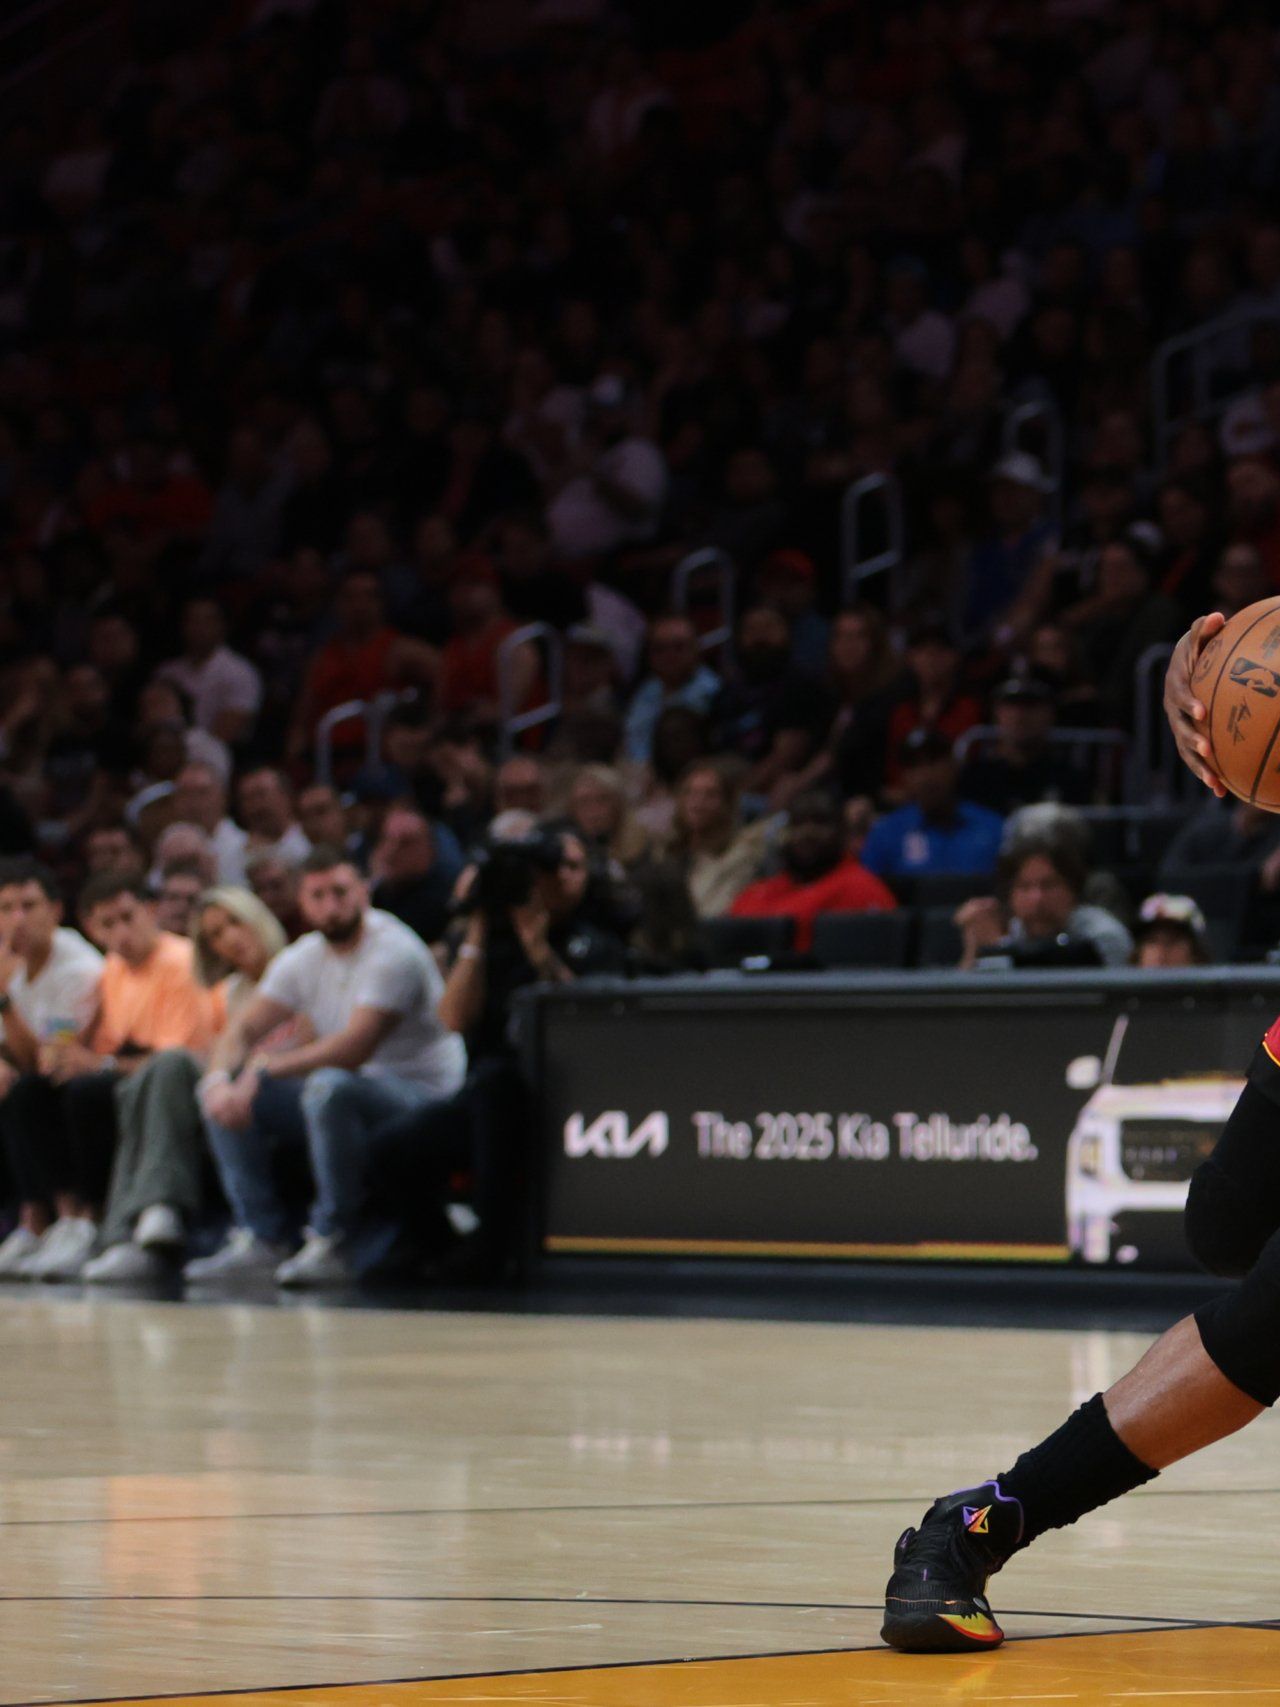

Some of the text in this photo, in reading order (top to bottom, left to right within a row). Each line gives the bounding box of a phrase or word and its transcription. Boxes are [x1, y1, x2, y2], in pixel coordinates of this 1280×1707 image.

[691, 1110, 1039, 1163] The 2025 Kia Telluride.
